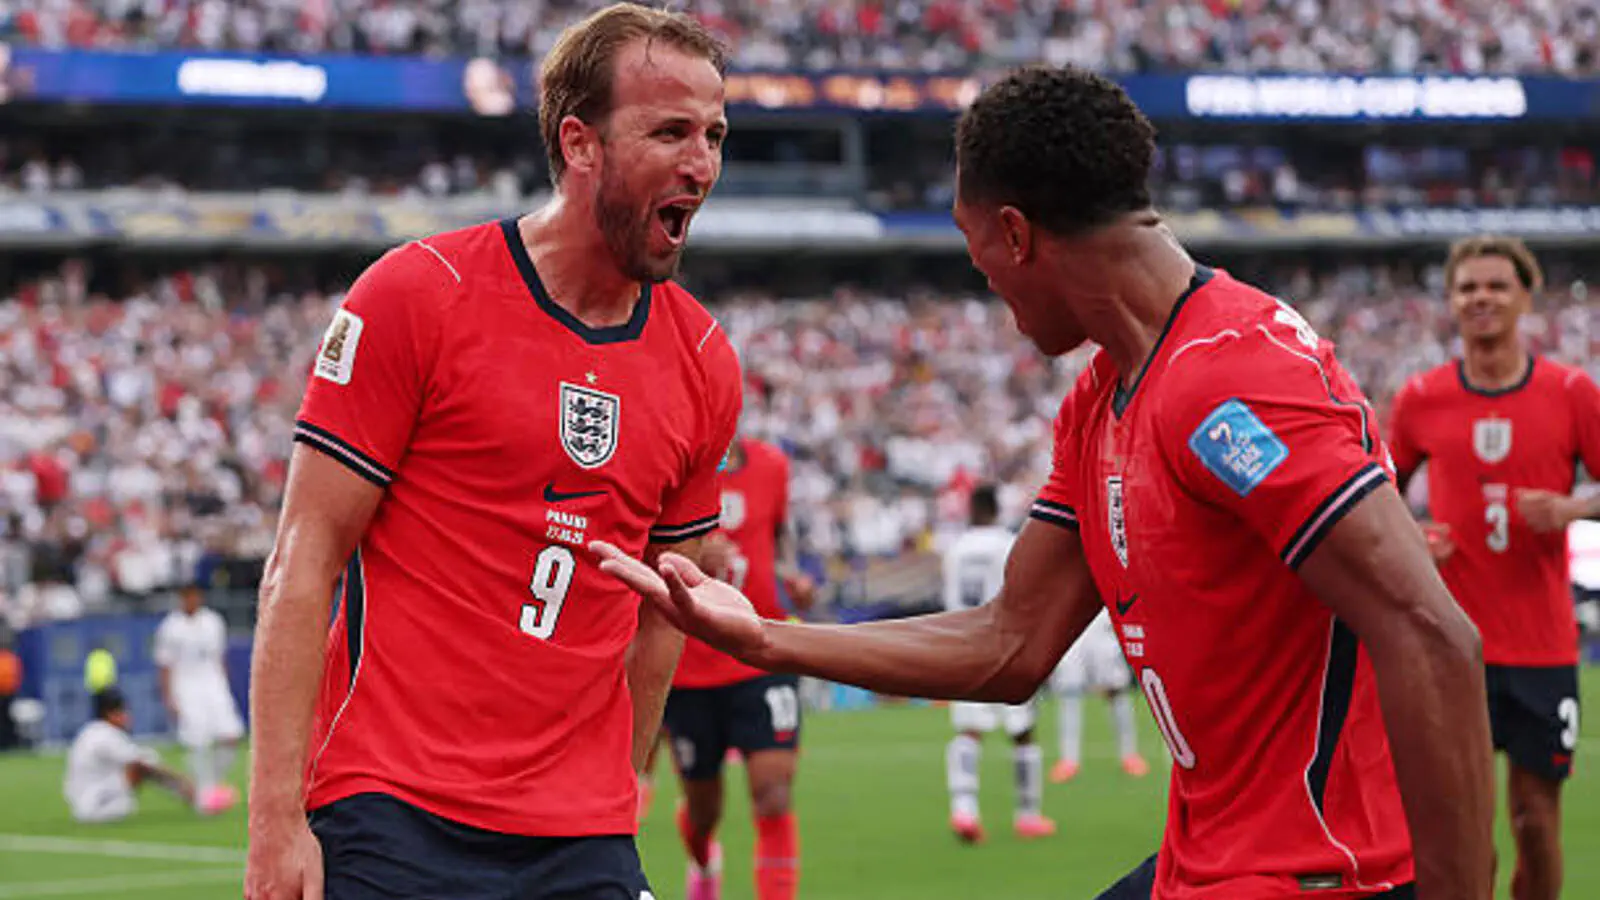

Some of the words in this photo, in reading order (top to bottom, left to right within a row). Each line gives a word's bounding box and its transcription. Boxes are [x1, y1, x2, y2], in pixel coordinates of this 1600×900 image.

[1485, 503, 1508, 552] 3
[519, 544, 576, 640] 9
[1558, 697, 1578, 750] 3
